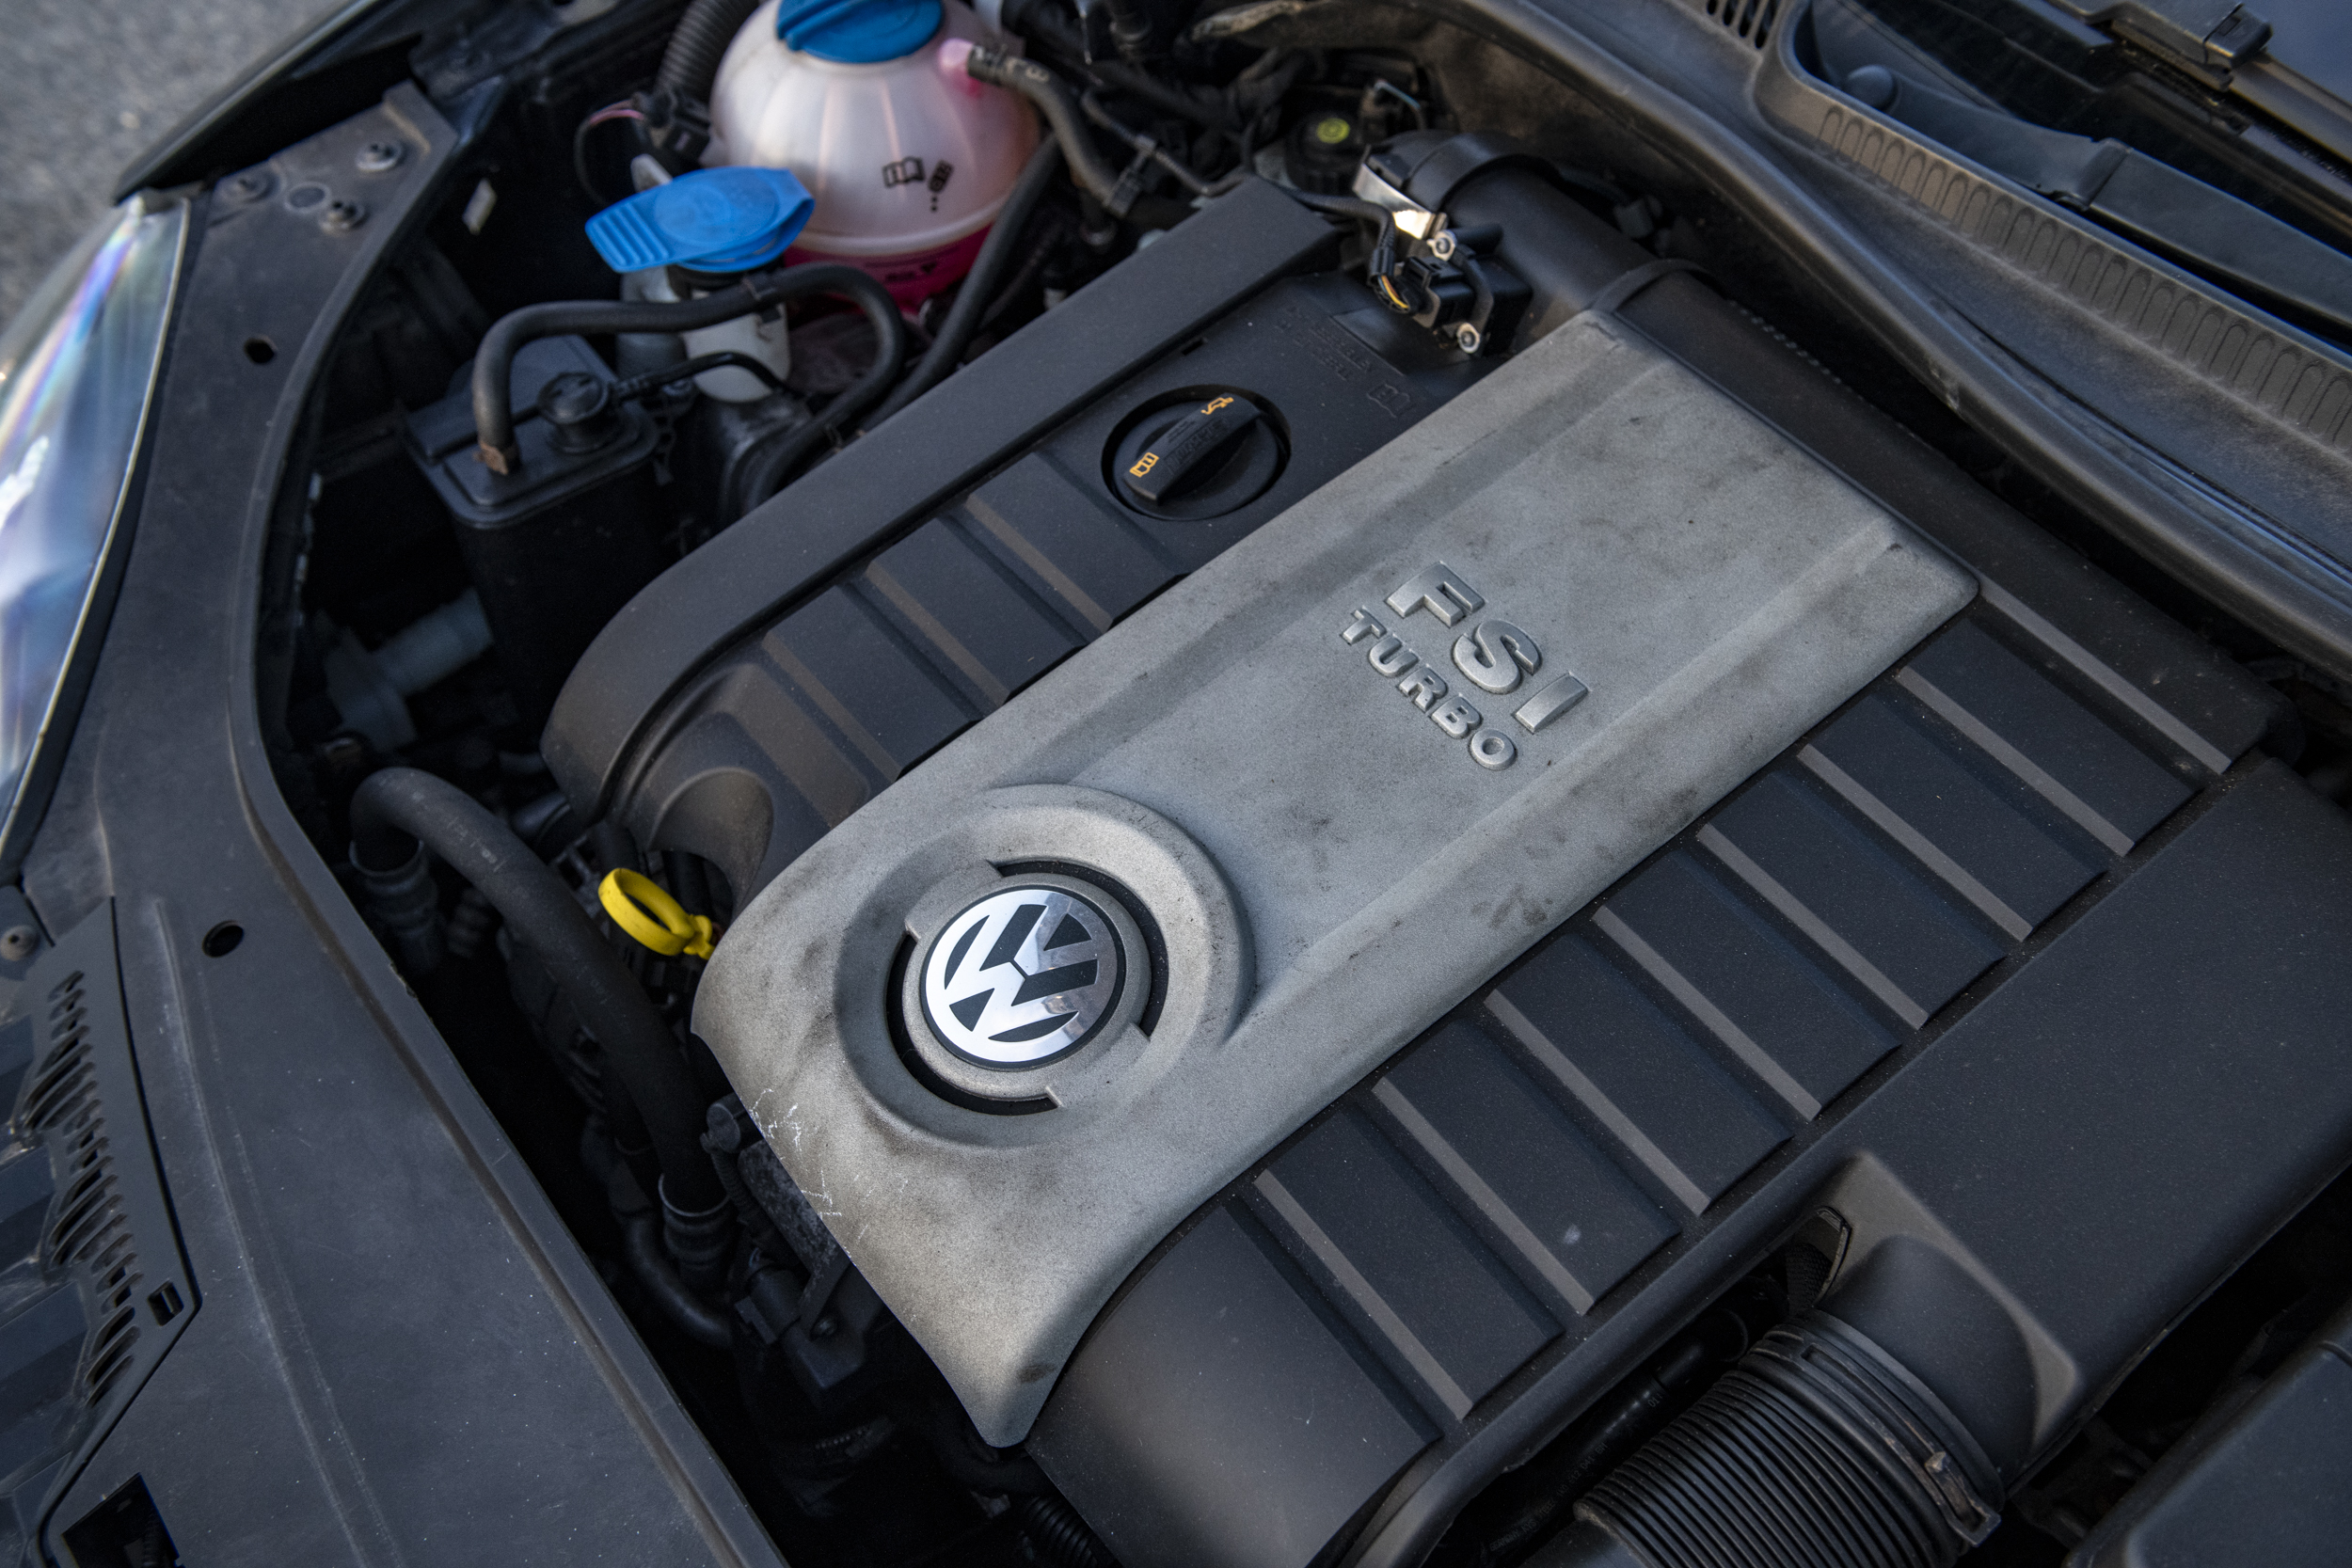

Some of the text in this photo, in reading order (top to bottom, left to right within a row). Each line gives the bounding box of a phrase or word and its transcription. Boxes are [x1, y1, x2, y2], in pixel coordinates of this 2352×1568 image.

[1341, 606, 1518, 769] TURBO
[1385, 562, 1591, 734] FSI
[926, 889, 1118, 1062] VW
